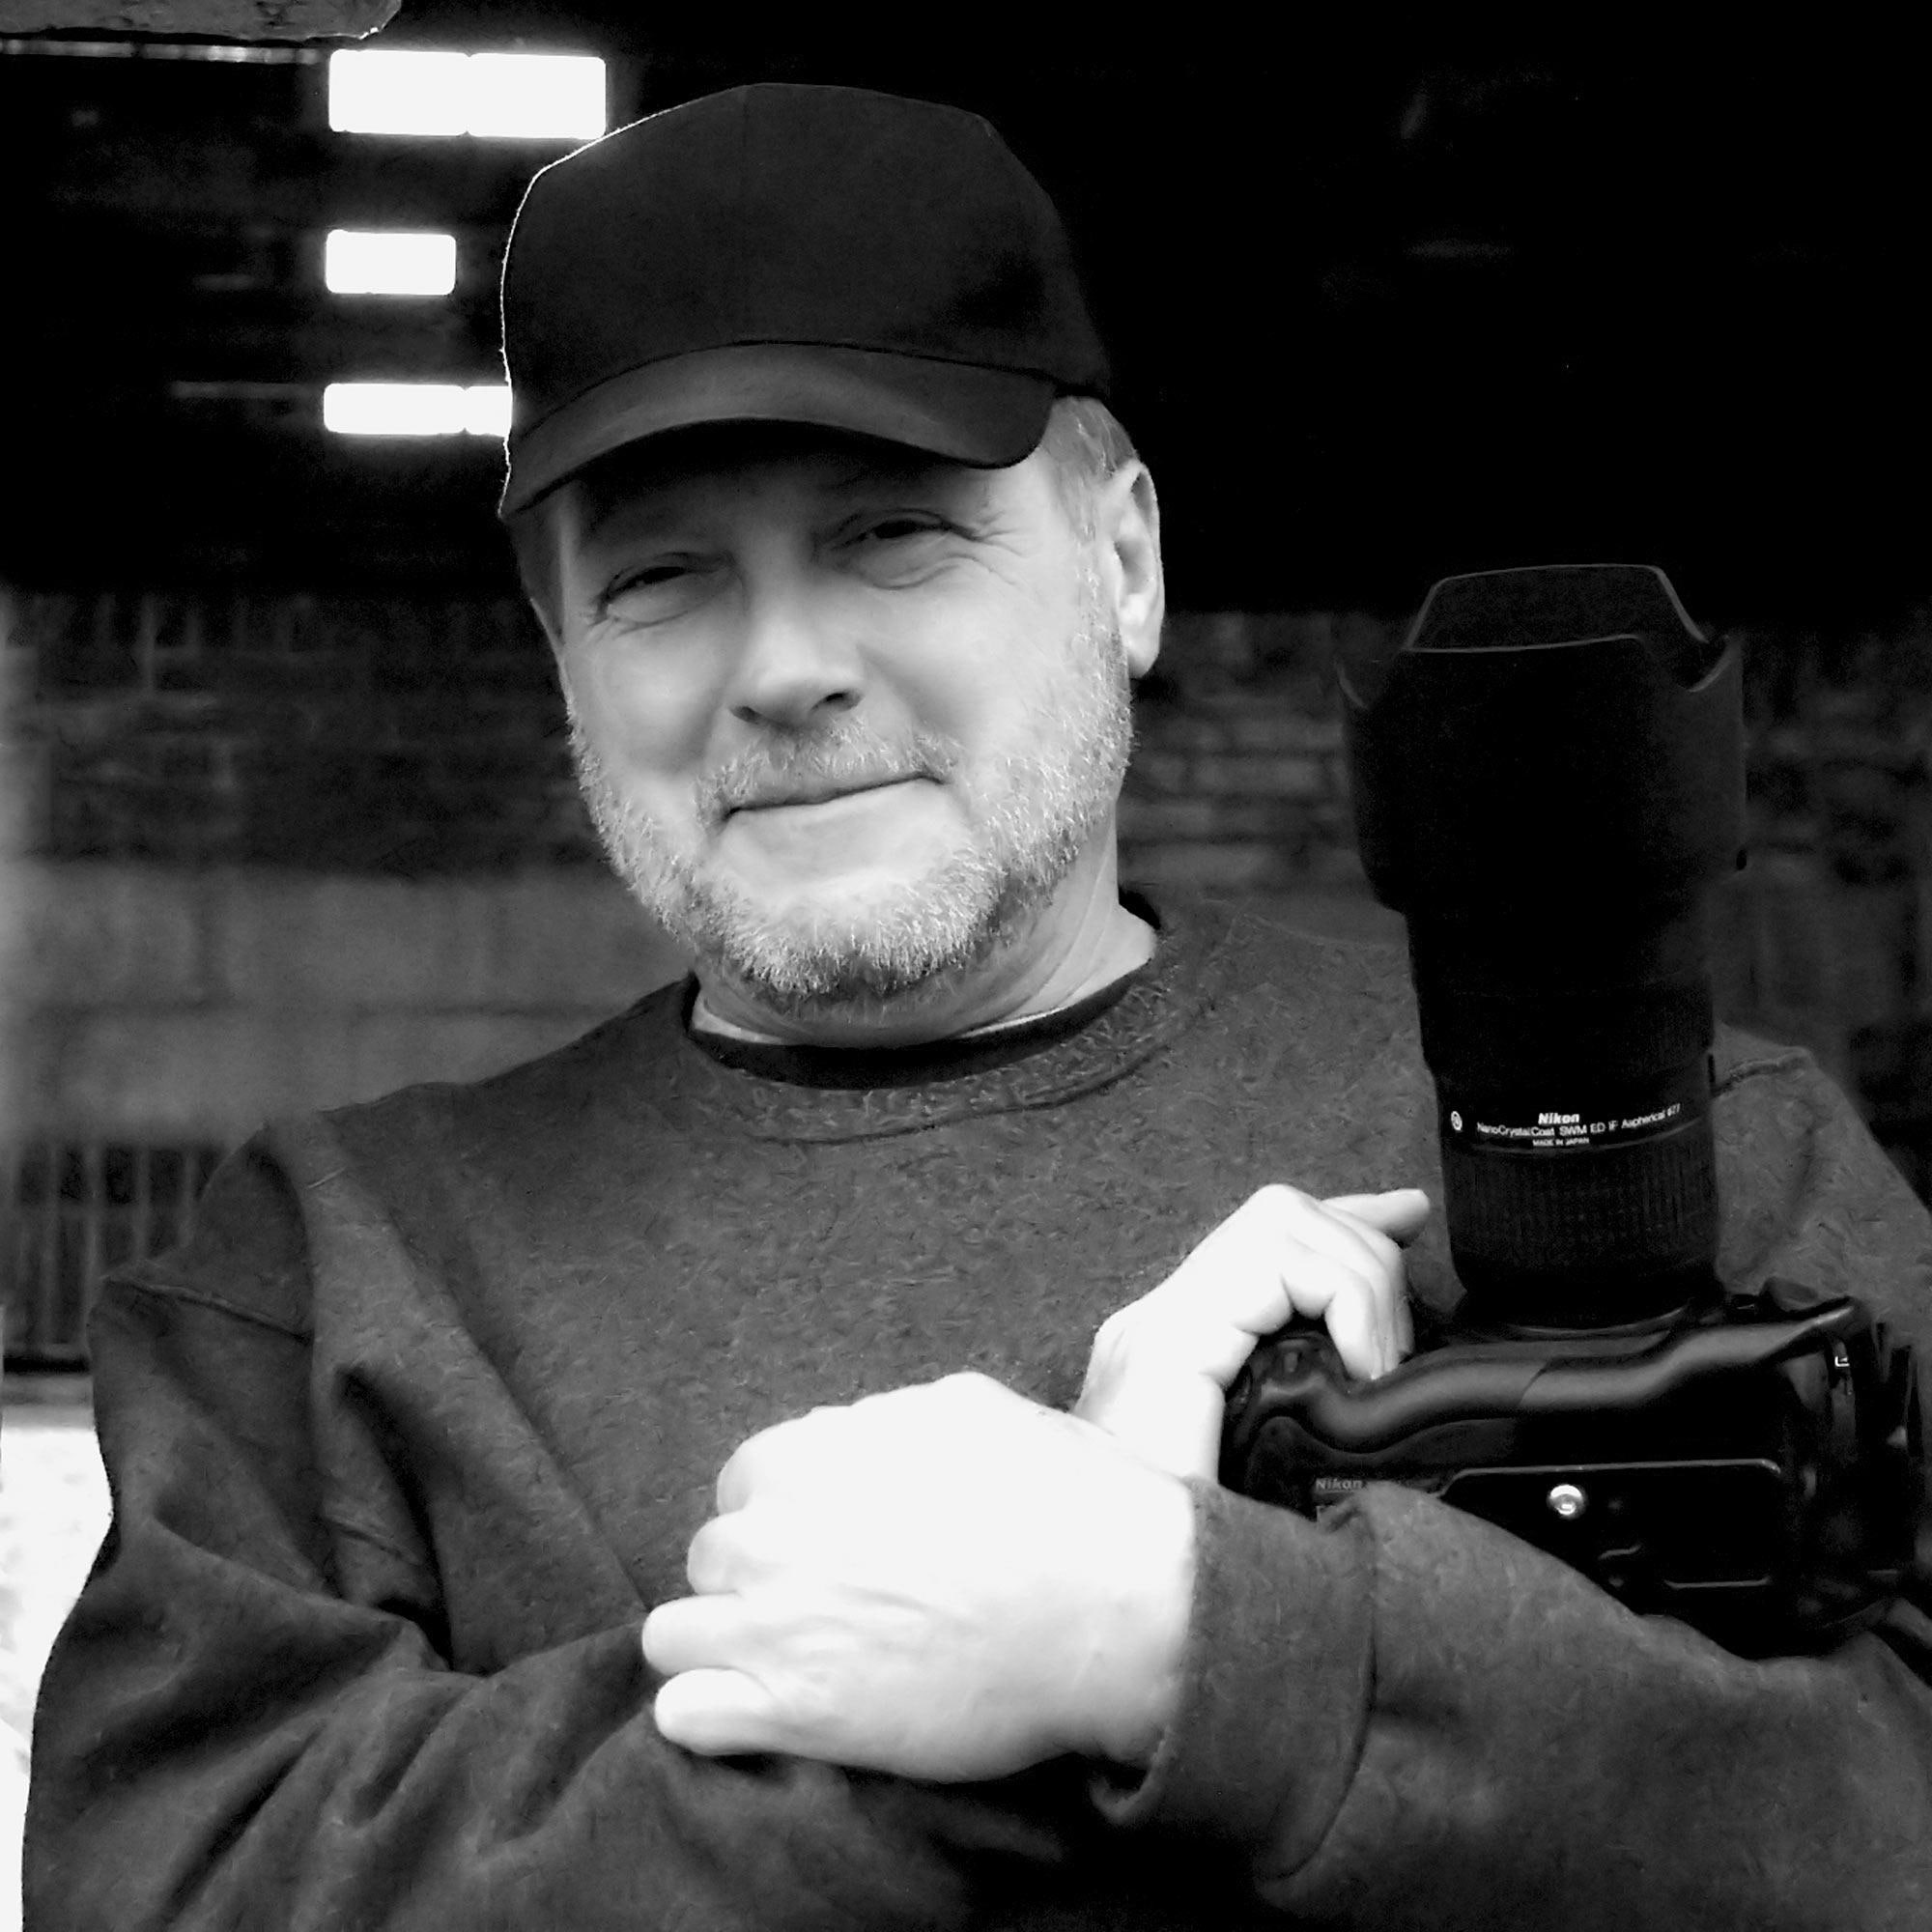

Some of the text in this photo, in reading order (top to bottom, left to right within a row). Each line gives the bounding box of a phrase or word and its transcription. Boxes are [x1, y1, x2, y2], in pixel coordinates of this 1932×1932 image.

[1538, 1112, 1579, 1124] Nikon
[1559, 1124, 1587, 1136] SWM
[1590, 1122, 1605, 1133] ED
[1565, 1137, 1589, 1146] JAPAN
[1315, 1478, 1363, 1491] Nikon
